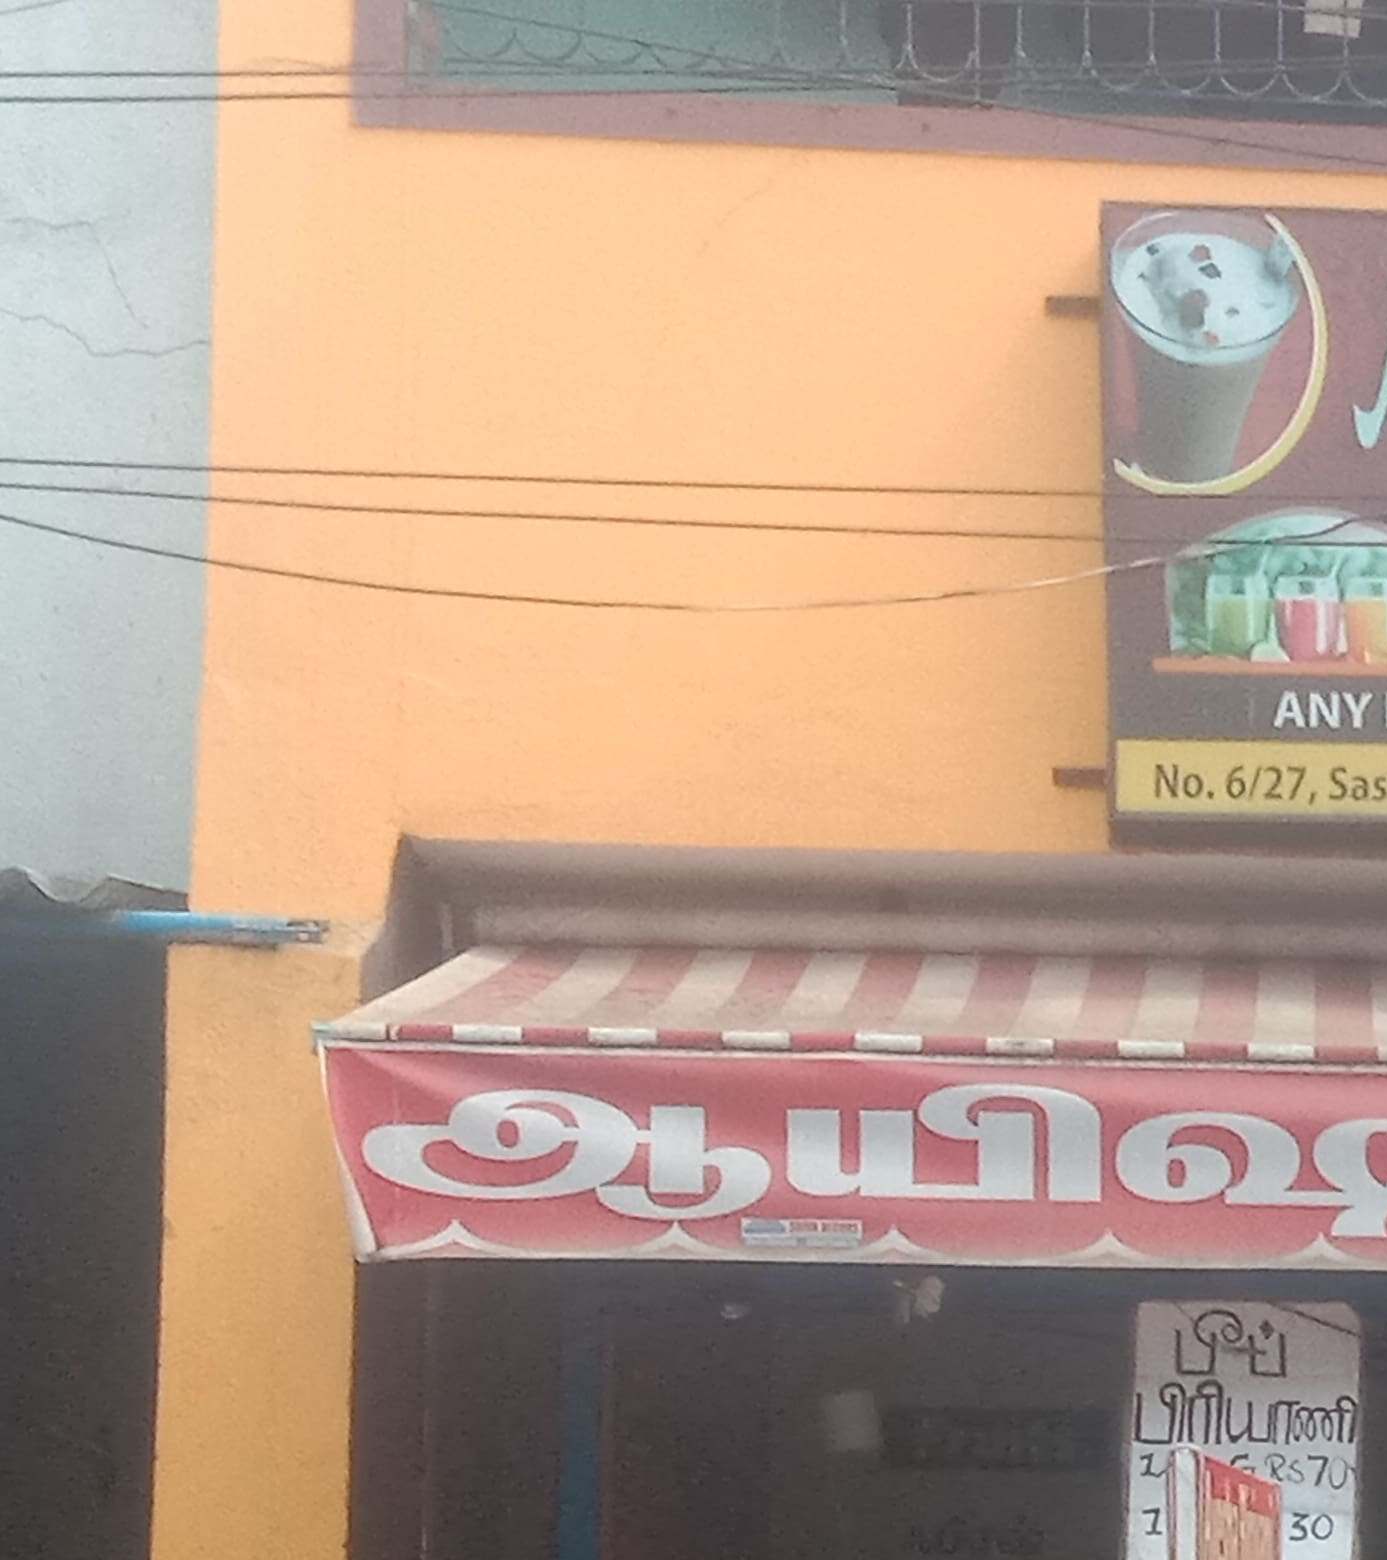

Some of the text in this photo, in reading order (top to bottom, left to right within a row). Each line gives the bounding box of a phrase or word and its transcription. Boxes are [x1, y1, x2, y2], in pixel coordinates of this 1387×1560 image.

[1273, 690, 1374, 729] ANY
[1153, 763, 1215, 800] No.
[1225, 765, 1319, 806] 6/27,
[1133, 1379, 1358, 1445] பிரியாணி
[1288, 1511, 1335, 1542] 30
